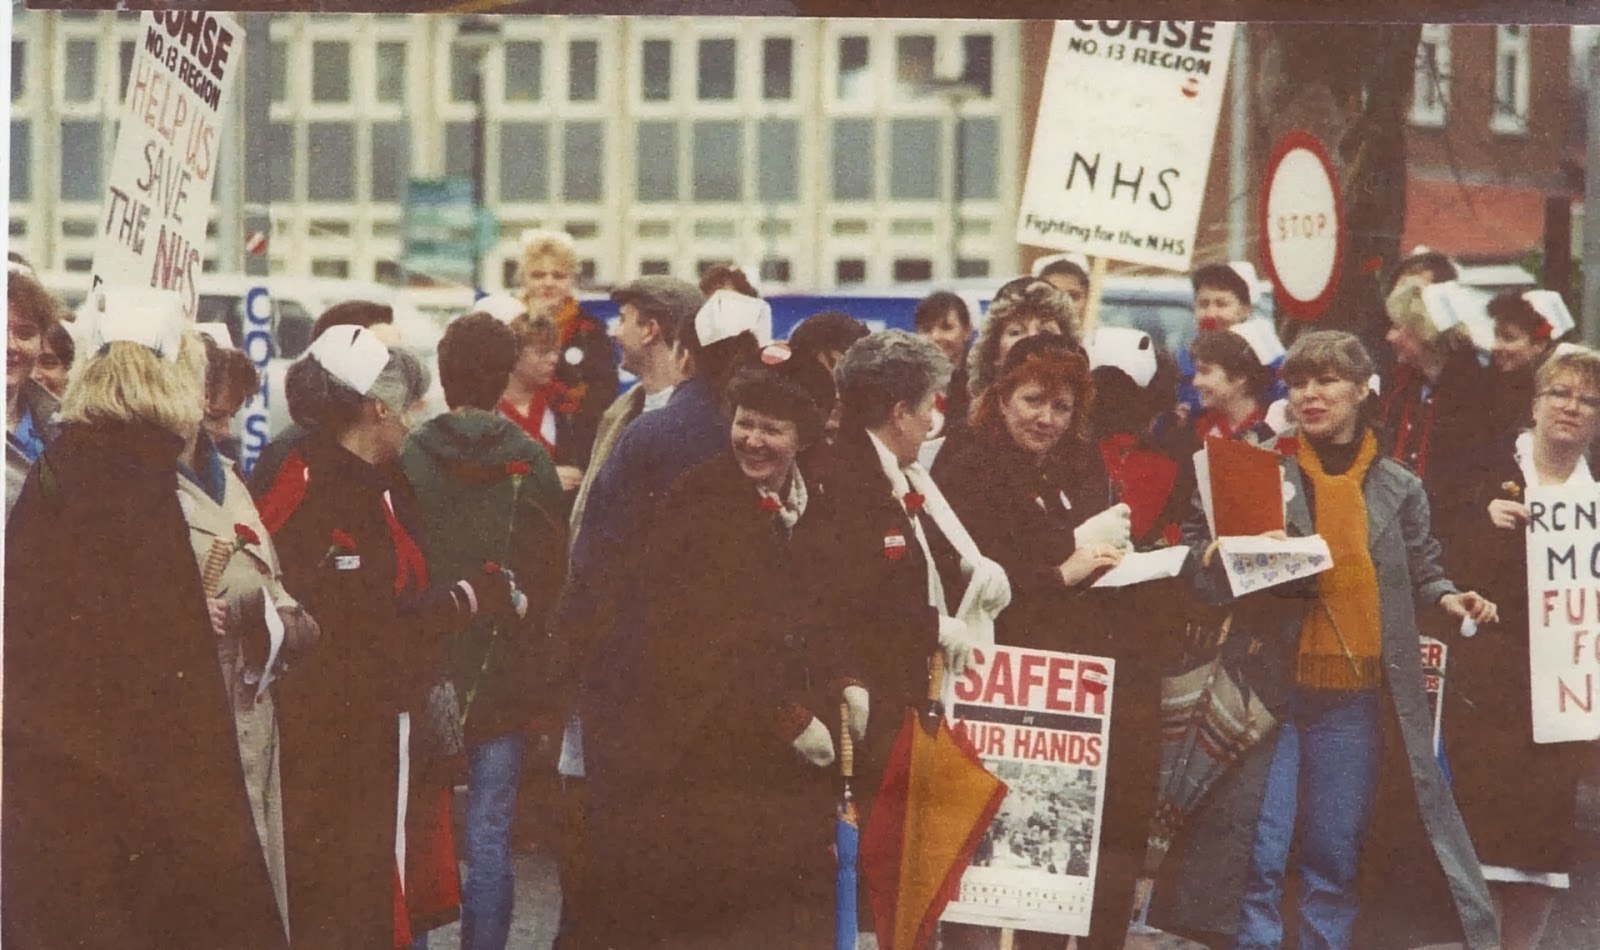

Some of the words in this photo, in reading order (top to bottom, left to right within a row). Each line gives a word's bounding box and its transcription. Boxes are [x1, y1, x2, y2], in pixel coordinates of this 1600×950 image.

[179, 55, 221, 112] REGION
[1106, 44, 1126, 61] 13
[1133, 47, 1212, 75] REGION
[131, 56, 188, 146] HELP
[185, 106, 214, 181] US
[136, 140, 191, 224] SAVE
[1064, 151, 1181, 212] NHS
[105, 186, 151, 256] THE
[150, 224, 200, 318] NHS
[1025, 213, 1092, 243] Fighting
[1094, 224, 1116, 242] for
[1118, 230, 1143, 248] the
[1145, 234, 1186, 257] NHS
[1276, 212, 1327, 241] STOP
[1530, 501, 1597, 533] RCN
[953, 647, 1109, 715] SAFER
[966, 722, 1005, 756] UR
[1014, 728, 1101, 767] HANDS
